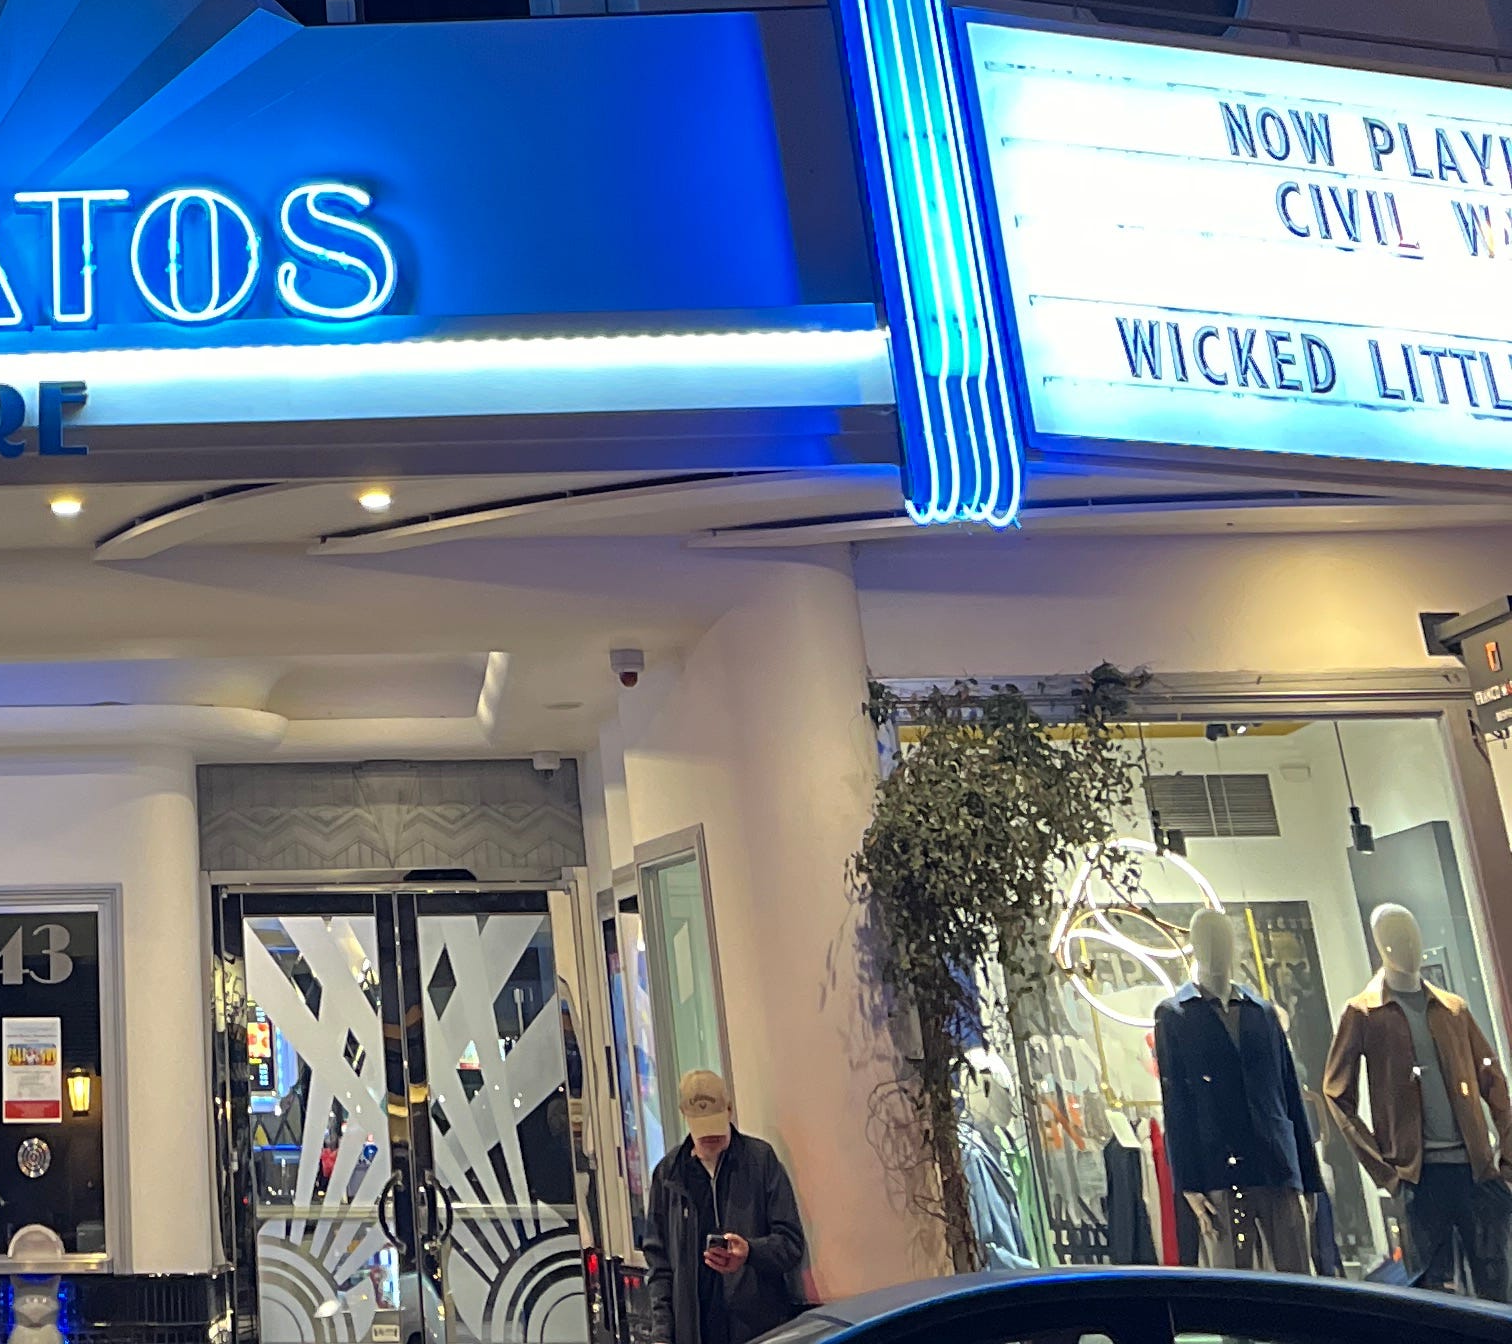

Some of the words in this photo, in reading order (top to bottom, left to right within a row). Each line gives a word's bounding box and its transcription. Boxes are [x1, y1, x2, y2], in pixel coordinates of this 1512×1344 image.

[1219, 101, 1335, 167] NOW
[1275, 180, 1421, 250] CIVIL
[1115, 317, 1337, 395] WICKED
[1368, 339, 1512, 411] LITTL
